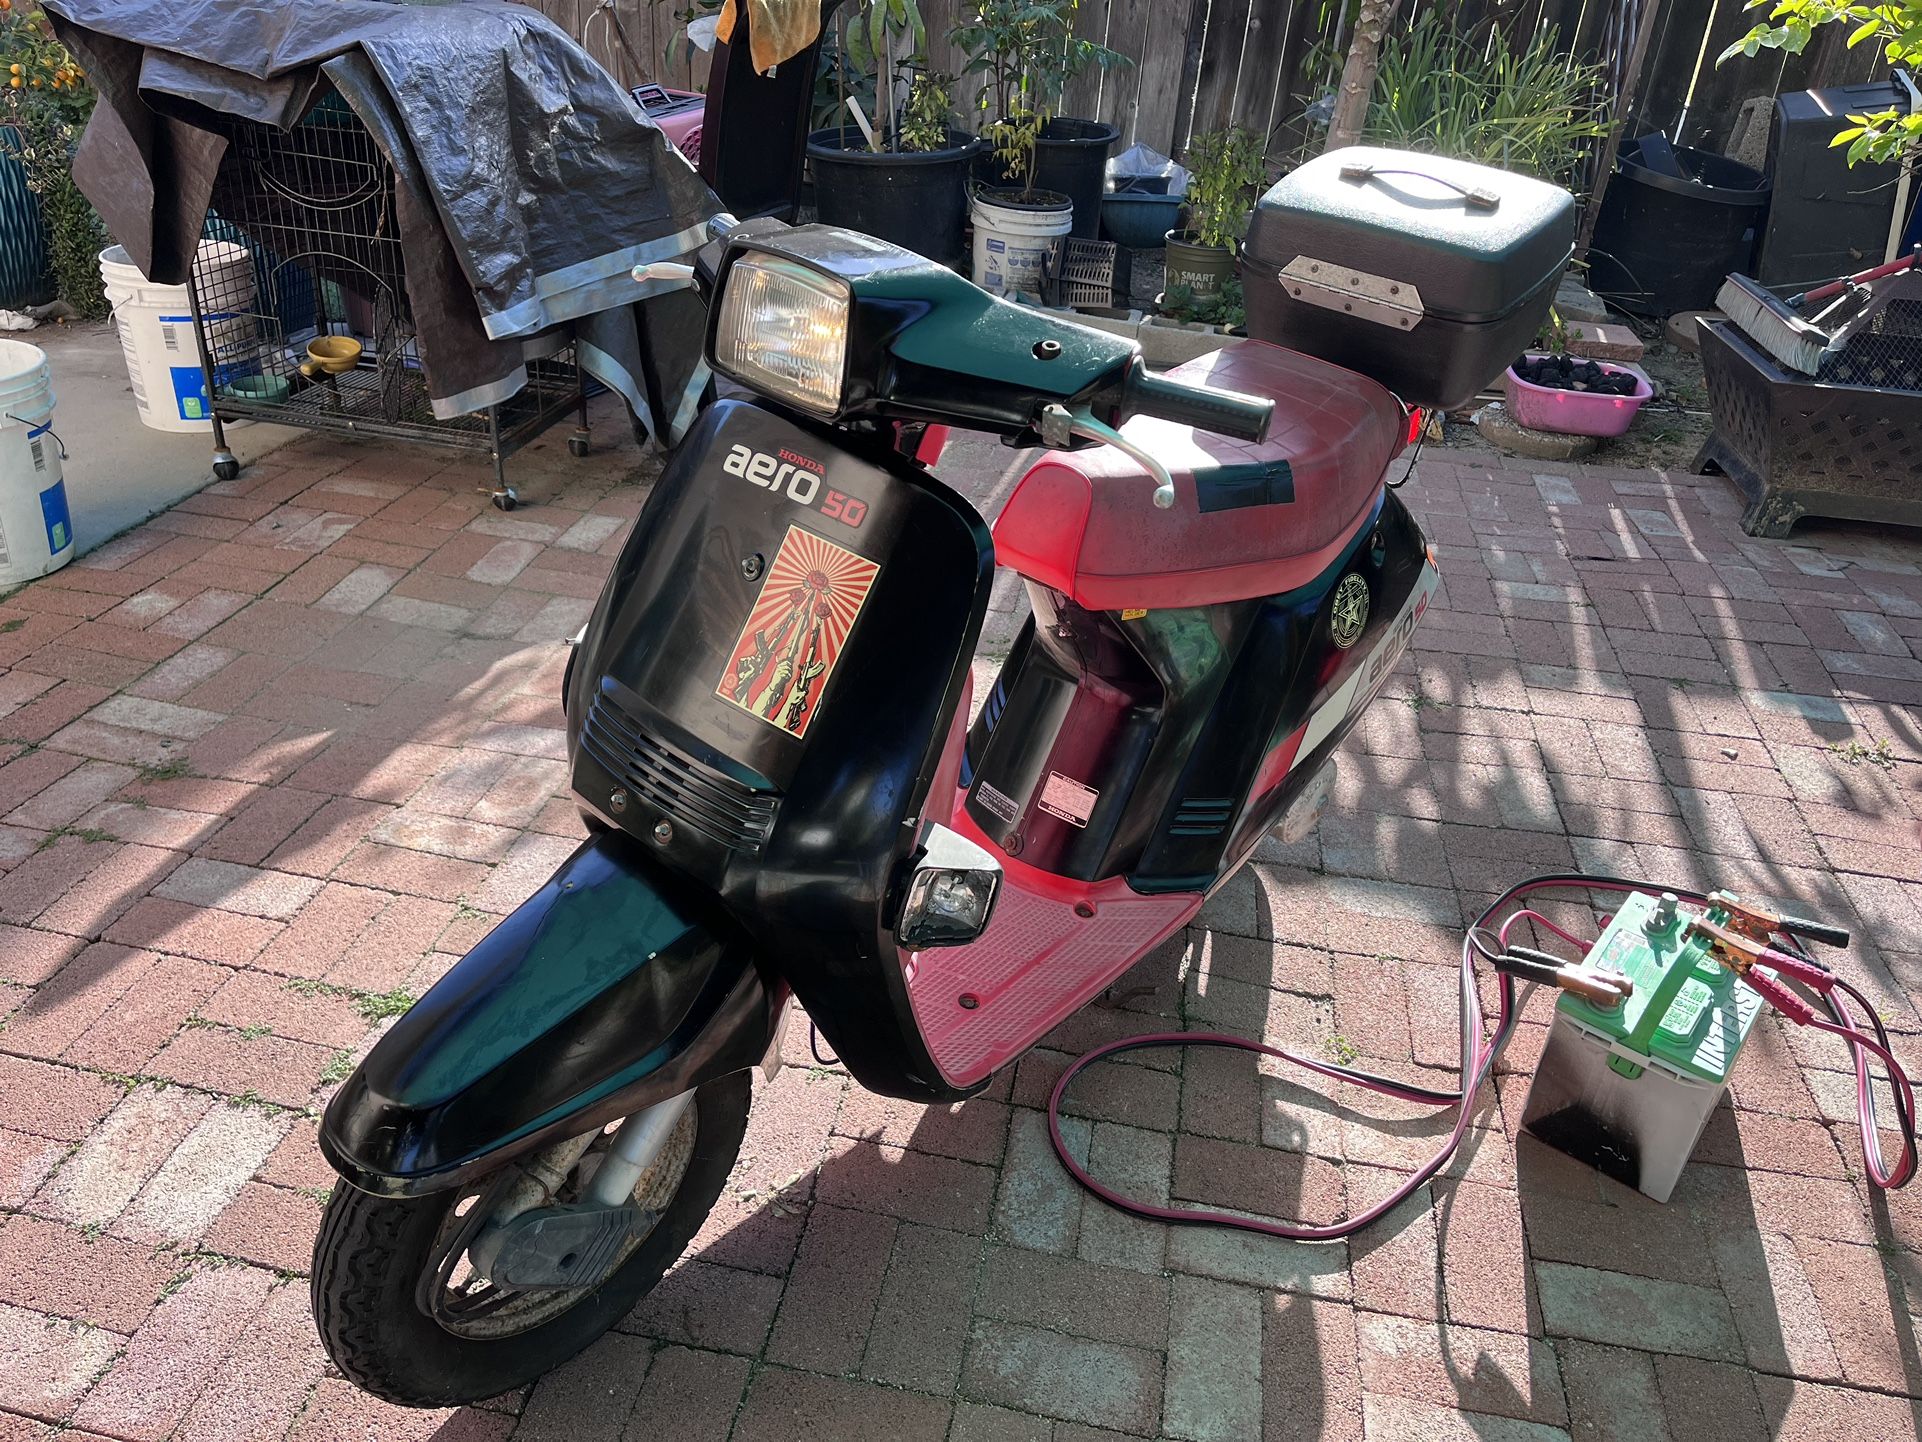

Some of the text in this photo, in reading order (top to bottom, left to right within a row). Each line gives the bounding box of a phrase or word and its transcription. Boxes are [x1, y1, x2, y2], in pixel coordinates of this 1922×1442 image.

[1180, 280, 1215, 289] PLANT
[1181, 271, 1215, 282] SMART
[778, 448, 825, 475] HONDA
[723, 443, 868, 529] aero 50
[1369, 611, 1414, 684] aero
[1047, 804, 1077, 822] HONDA
